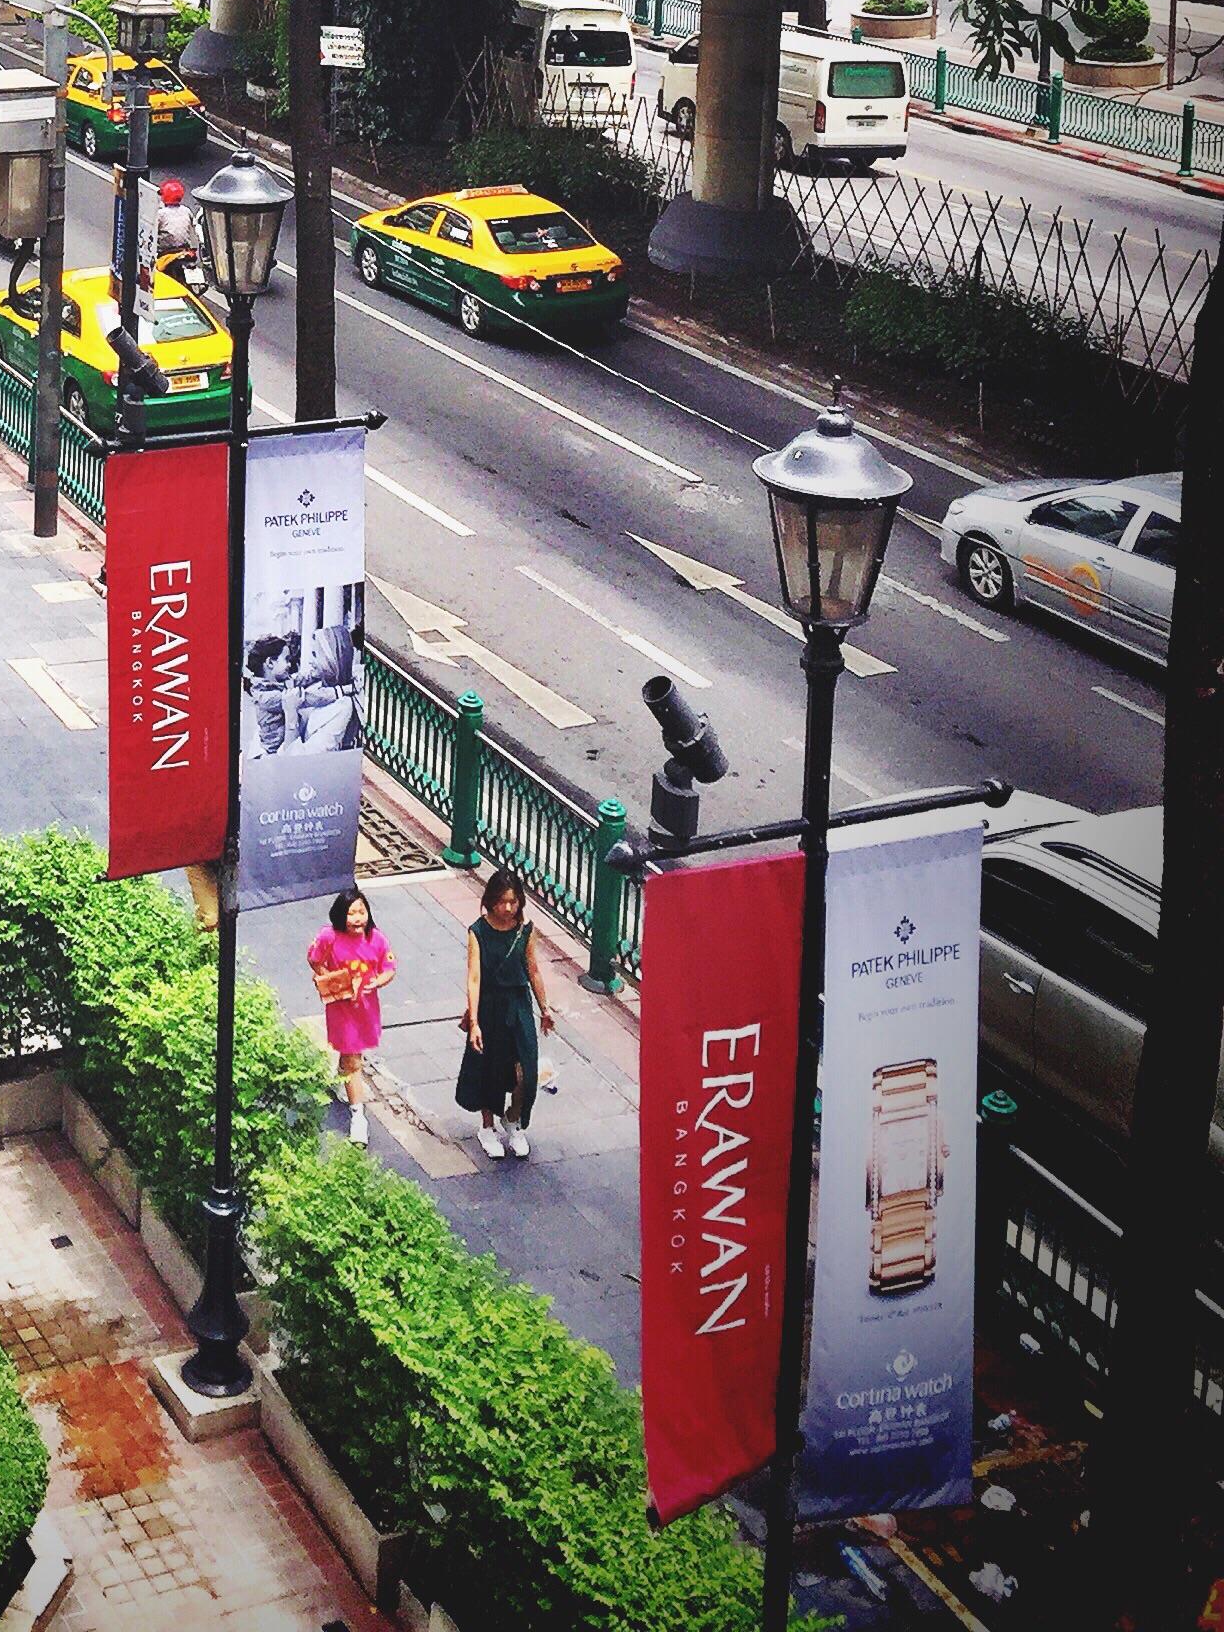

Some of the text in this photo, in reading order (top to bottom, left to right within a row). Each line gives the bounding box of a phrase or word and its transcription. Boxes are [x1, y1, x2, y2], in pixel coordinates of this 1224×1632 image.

[264, 509, 349, 528] PATEK PHILIPPE
[131, 610, 144, 723] BANGKOK
[145, 560, 192, 770] ERAWAN
[851, 943, 961, 979] PATEK PHILIPPE
[671, 1101, 688, 1273] BANGKOK
[695, 1023, 761, 1335] ERAWAN
[904, 1373, 954, 1399] watch
